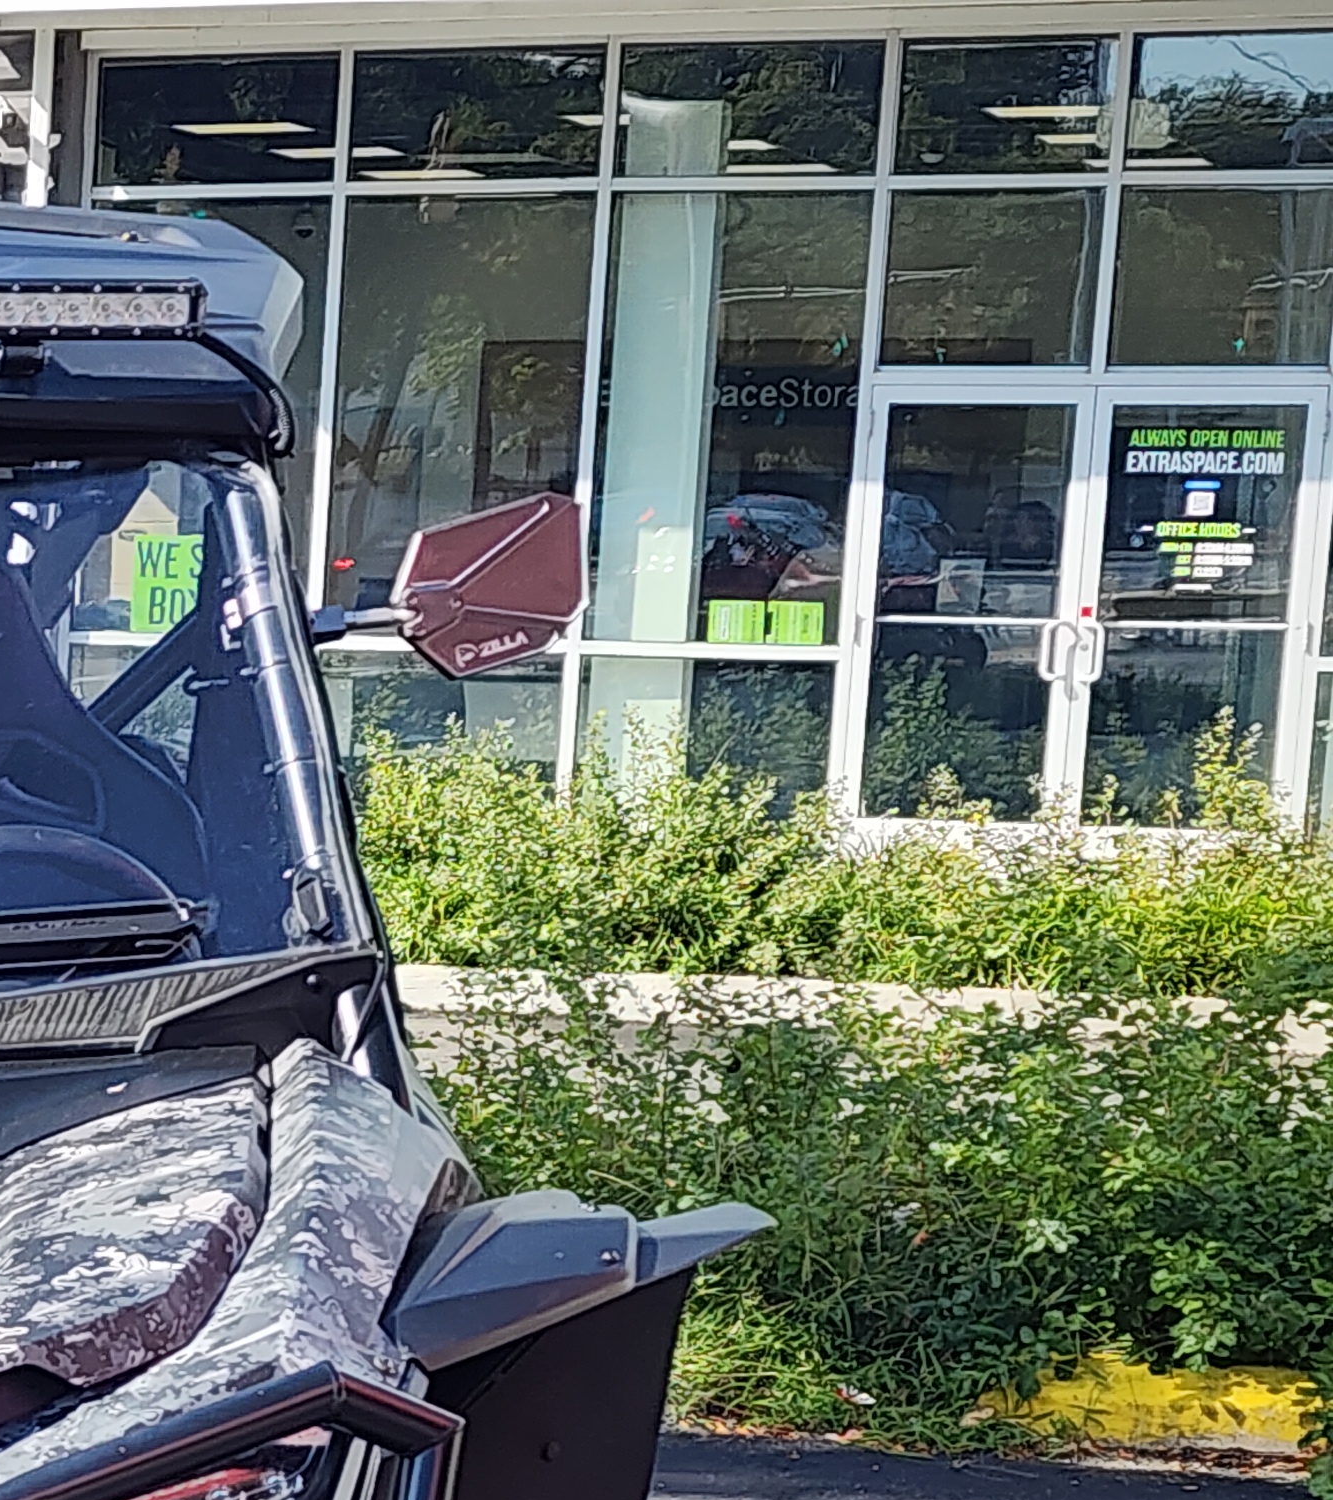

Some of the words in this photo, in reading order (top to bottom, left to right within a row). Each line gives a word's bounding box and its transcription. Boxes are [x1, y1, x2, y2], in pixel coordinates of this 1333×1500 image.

[1128, 429, 1187, 447] ALWAYS
[1189, 429, 1229, 448] OPEN
[1232, 429, 1285, 448] ONLINE
[1125, 451, 1285, 474] EXTRASPACE.COM
[1156, 521, 1198, 537] OFFICE
[1198, 522, 1241, 538] HOURS
[137, 540, 181, 579] WE
